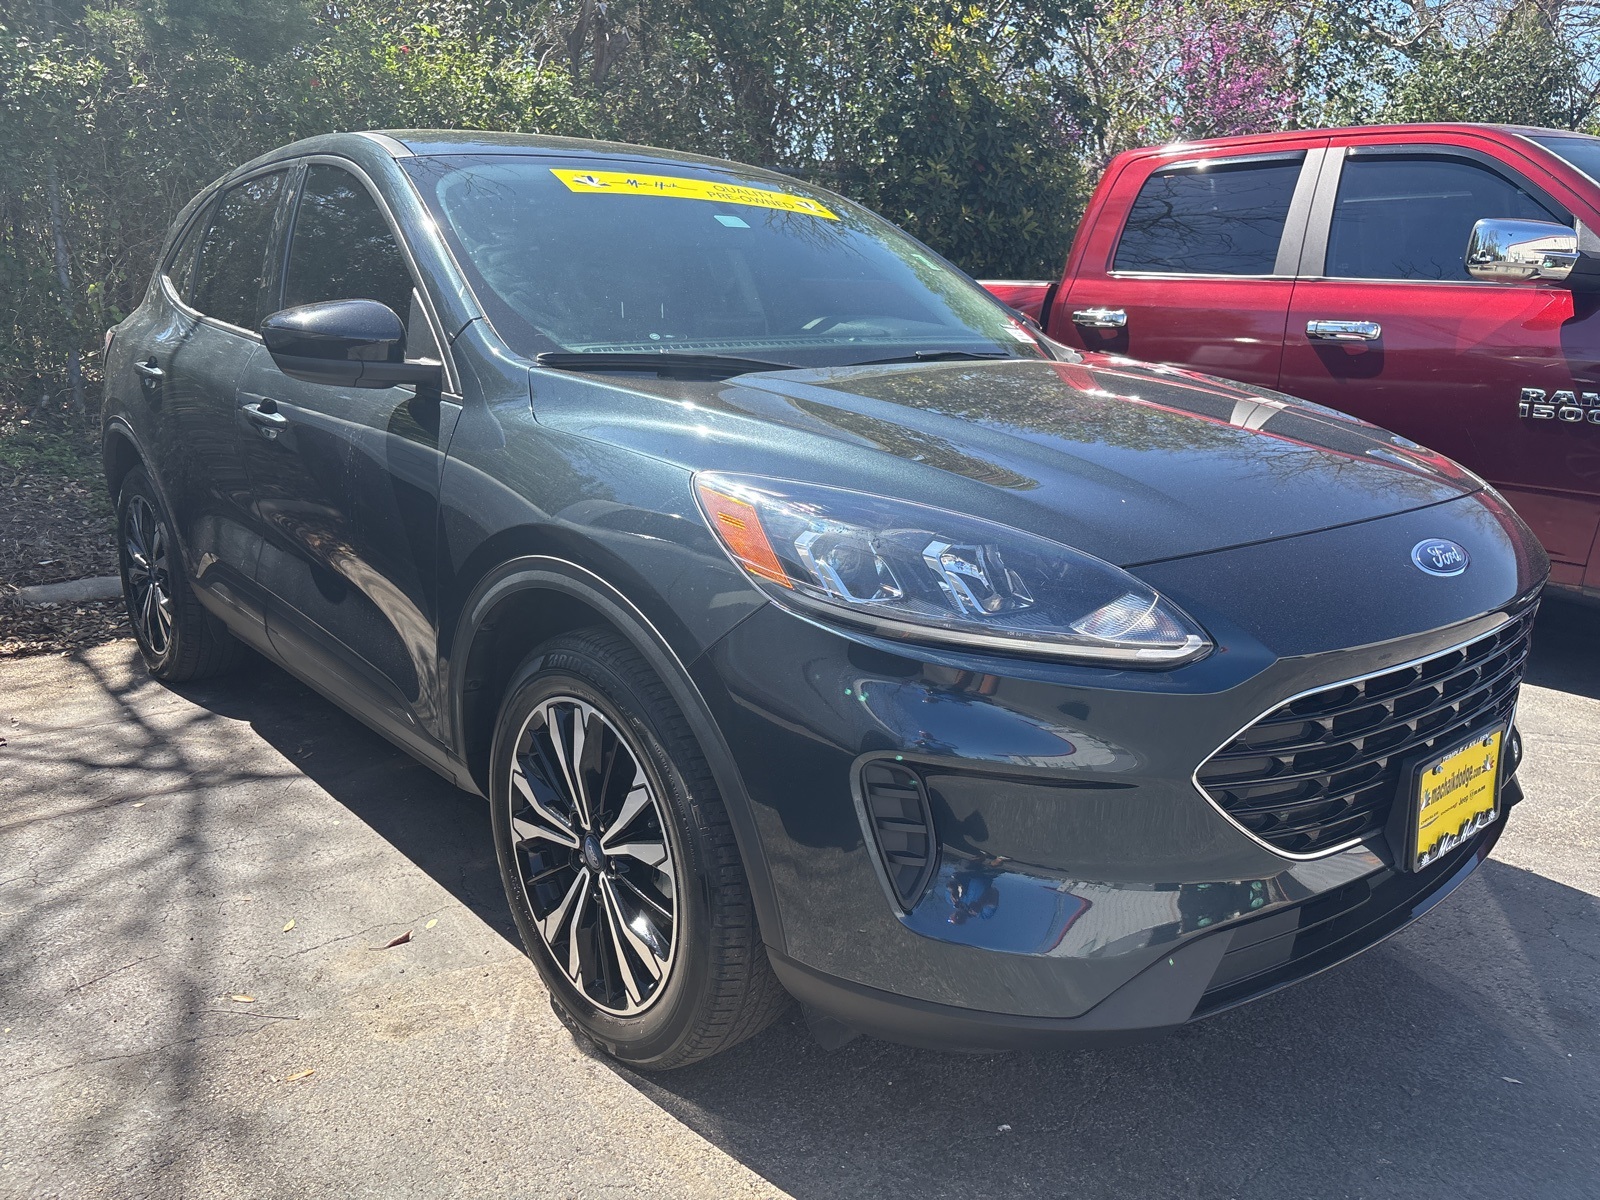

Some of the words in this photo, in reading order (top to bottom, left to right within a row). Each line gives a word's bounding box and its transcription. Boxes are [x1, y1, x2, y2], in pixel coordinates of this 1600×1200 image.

[706, 190, 795, 210] PRE-OWNED
[713, 184, 774, 200] QUALITY
[1427, 544, 1462, 568] Ford
[1458, 795, 1469, 806] Jeep
